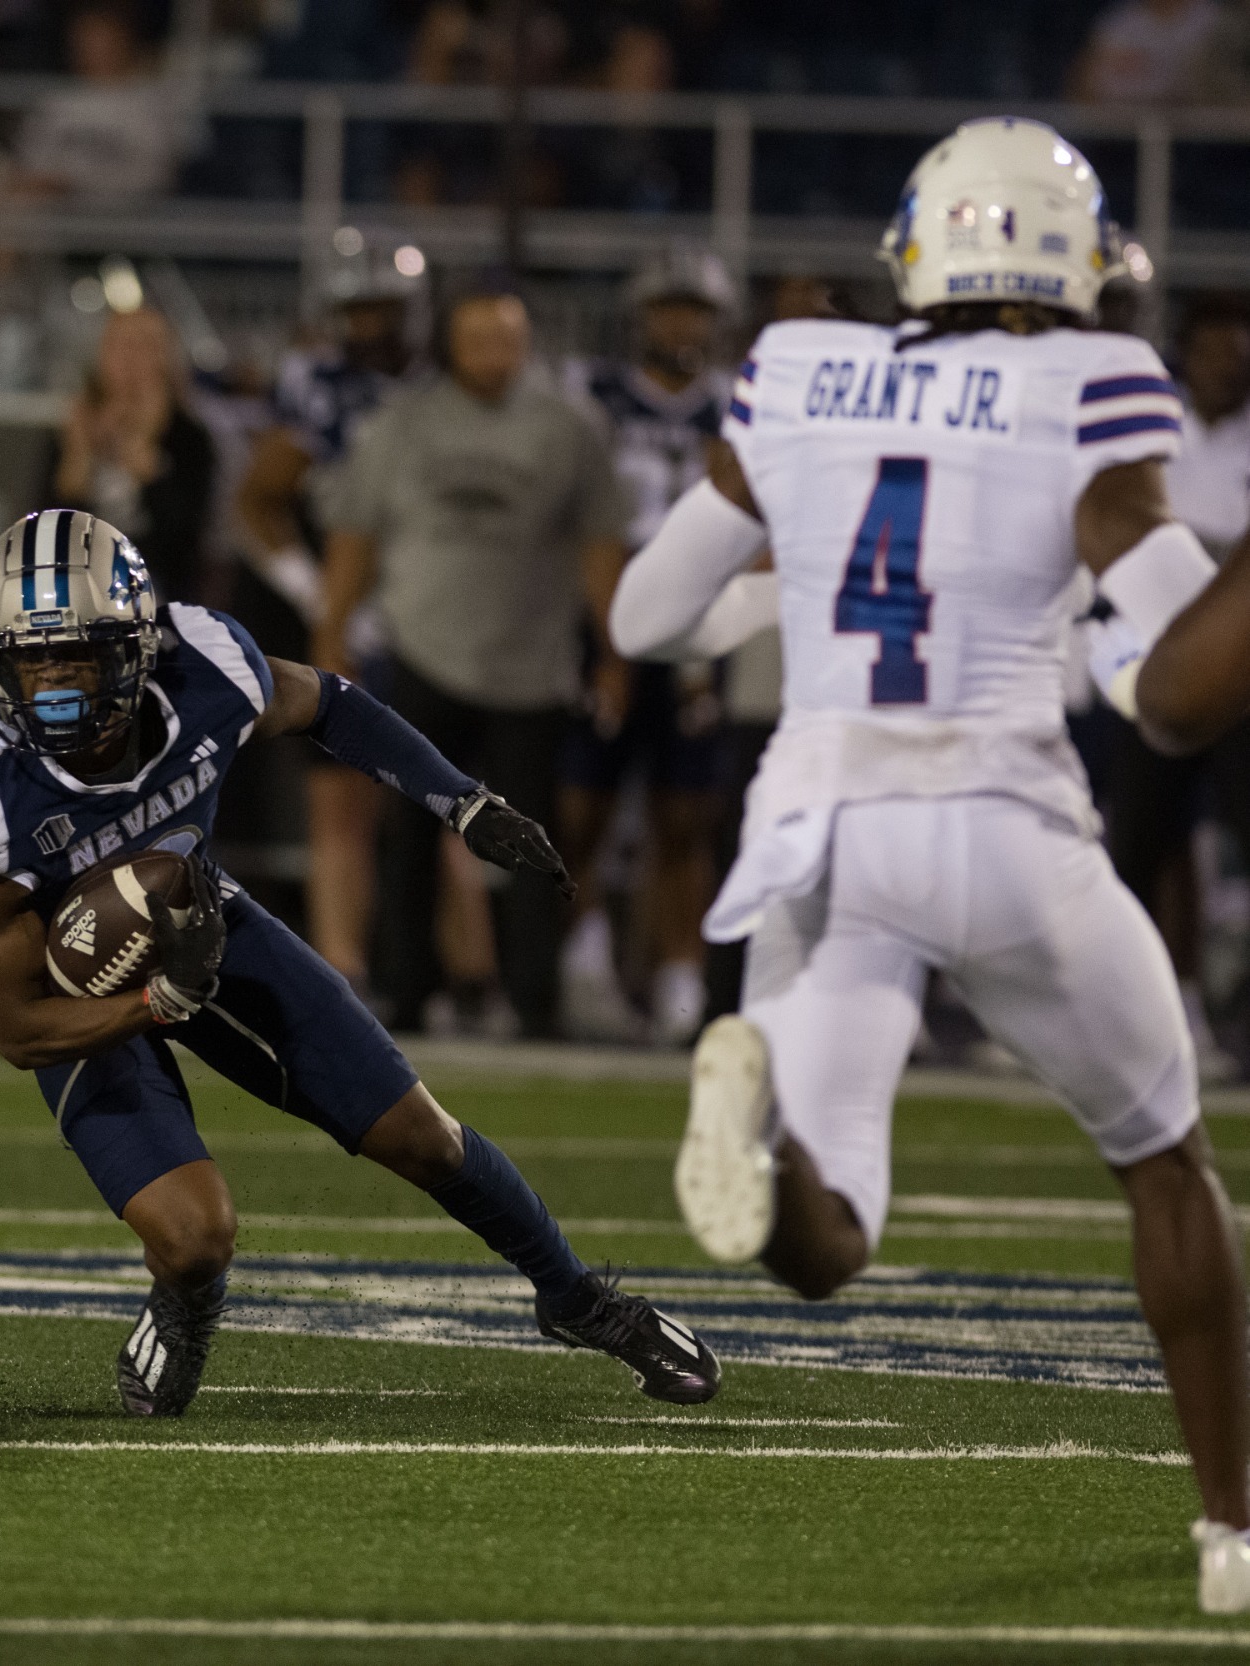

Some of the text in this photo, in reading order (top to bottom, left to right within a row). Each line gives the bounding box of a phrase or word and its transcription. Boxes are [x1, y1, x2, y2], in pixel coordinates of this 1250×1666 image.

[805, 359, 1009, 432] GRANT JR.
[833, 456, 934, 705] 4
[68, 758, 219, 876] NEVADA
[60, 908, 97, 949] adidas
